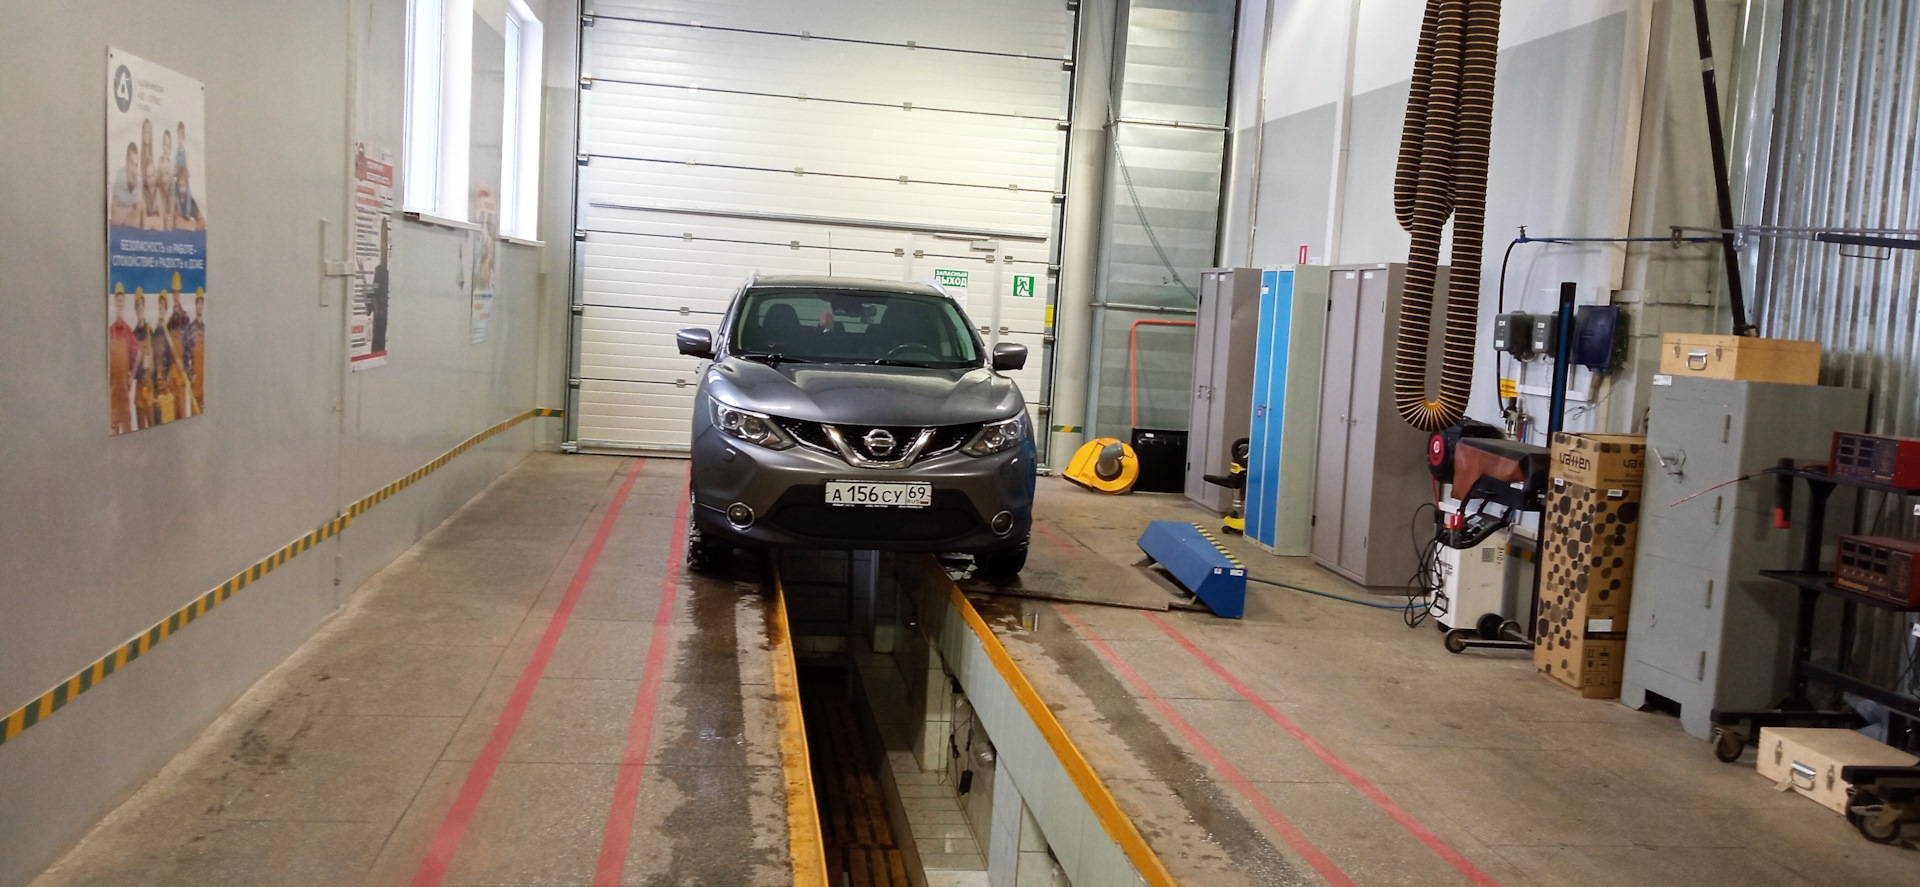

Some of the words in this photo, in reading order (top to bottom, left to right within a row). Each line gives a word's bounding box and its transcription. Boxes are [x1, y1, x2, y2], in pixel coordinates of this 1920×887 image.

[121, 239, 165, 253] БЕЗОПАСНОСТЬ
[173, 243, 194, 255] РАБОТЕ
[159, 256, 183, 269] РАДОСТЬ
[188, 258, 204, 270] ДОМЕ
[936, 276, 967, 287] ВЫХОД
